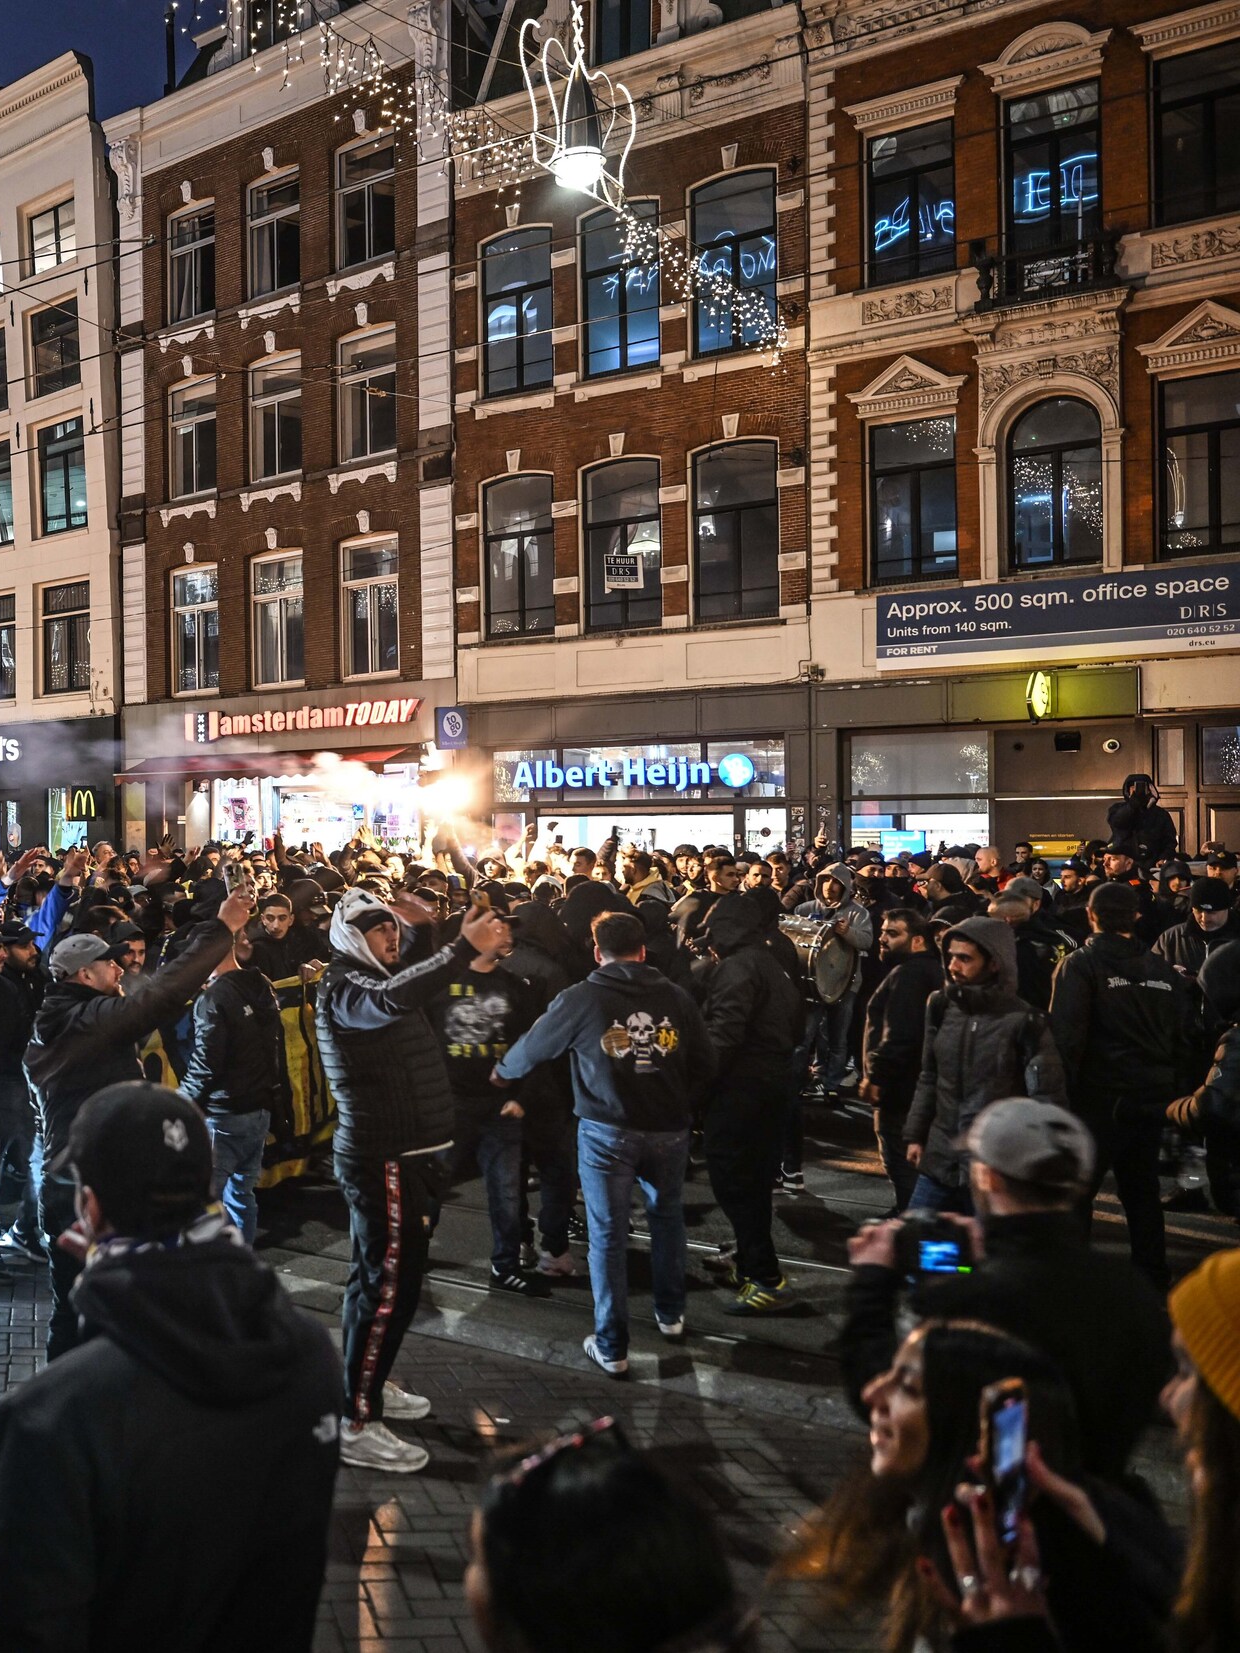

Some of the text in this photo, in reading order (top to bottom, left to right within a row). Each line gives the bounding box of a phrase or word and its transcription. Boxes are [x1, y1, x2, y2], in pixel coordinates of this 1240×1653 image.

[616, 557, 635, 565] HUUR
[886, 576, 1230, 621] Approx. 500 sqm. office space
[887, 620, 1012, 638] Units from 140 sqm.
[1167, 623, 1235, 636] 020 640 52 52
[886, 645, 938, 656] FOR RENT
[446, 715, 456, 725] to
[450, 721, 461, 735] go
[512, 756, 711, 792] Albert Heijn
